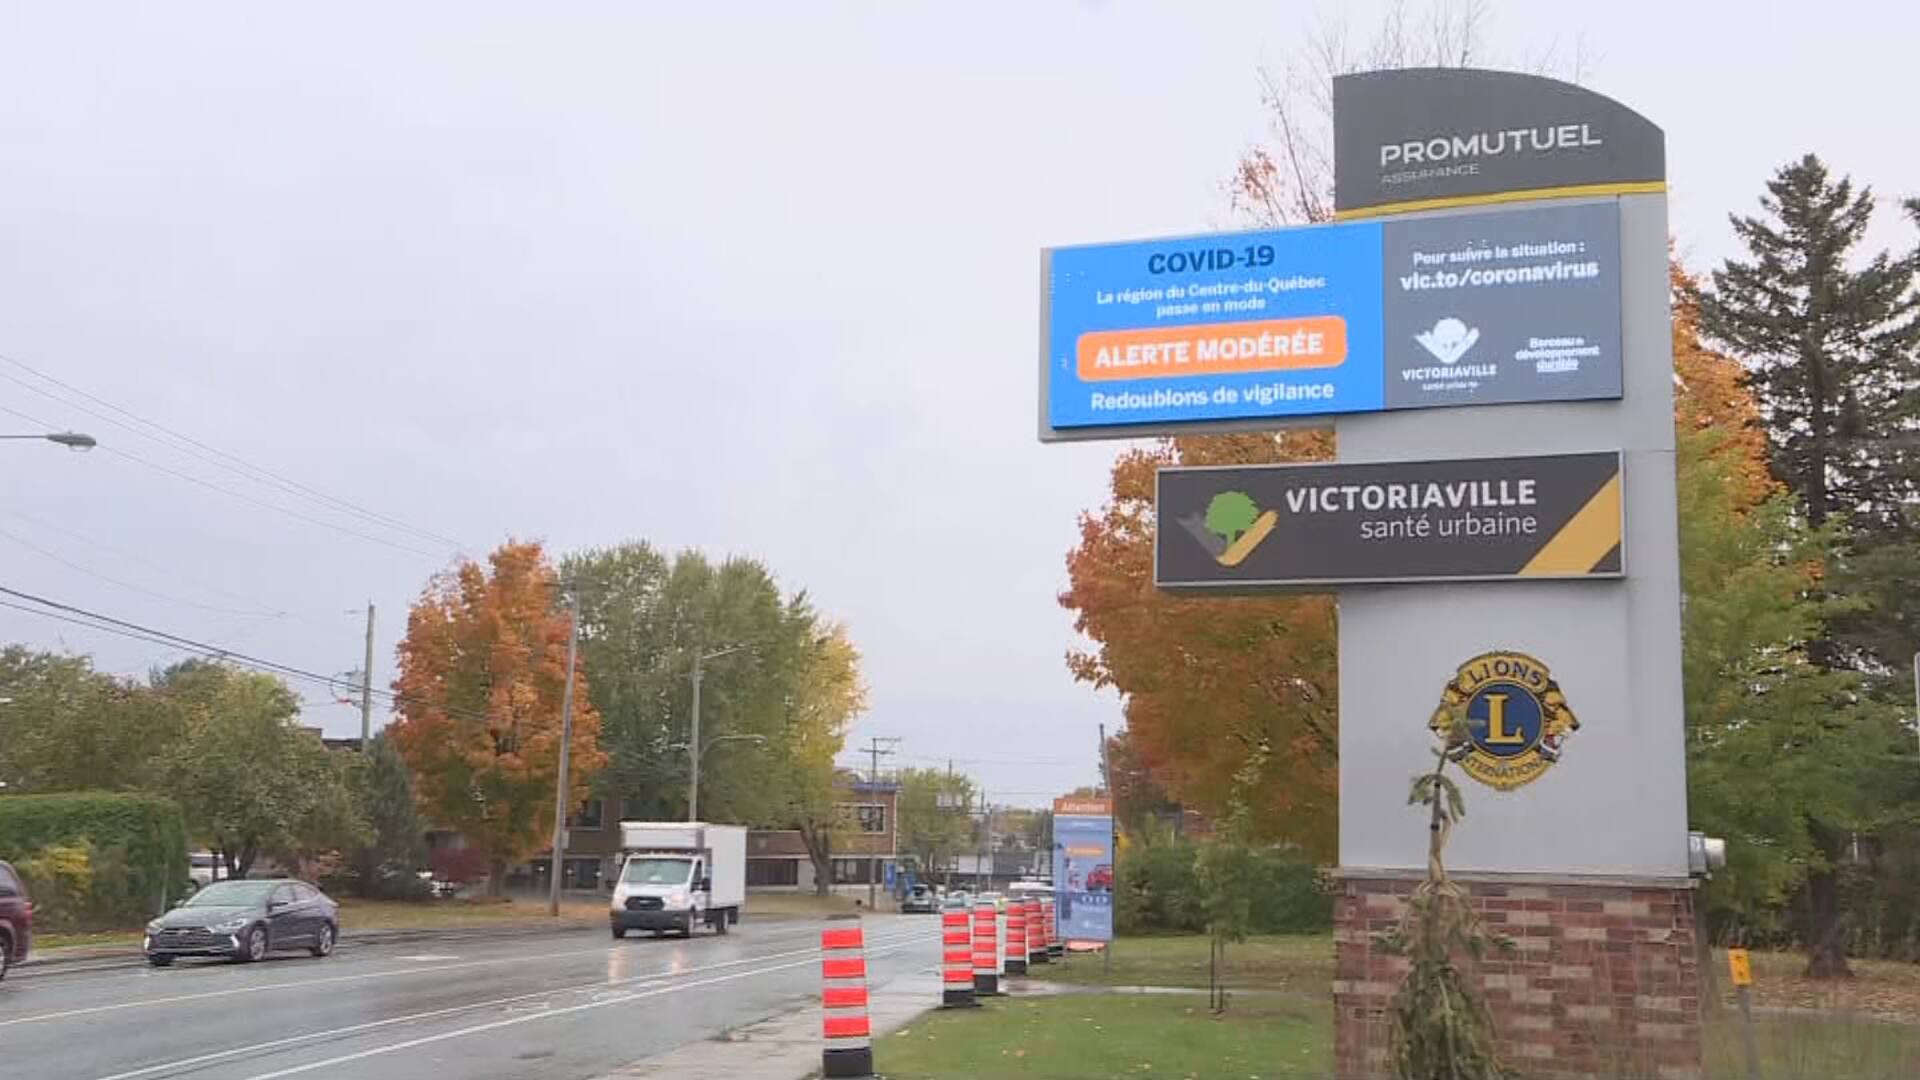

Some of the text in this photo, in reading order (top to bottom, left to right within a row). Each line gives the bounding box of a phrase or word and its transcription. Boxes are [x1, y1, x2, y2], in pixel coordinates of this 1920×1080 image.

[1380, 124, 1602, 166] PROMUTUEL
[1148, 244, 1275, 275] COVID-19
[1413, 251, 1446, 265] Pour
[1449, 247, 1492, 263] suivre
[1495, 245, 1508, 259] la
[1512, 241, 1577, 257] situation
[1400, 261, 1600, 291] vic.to/coronavirus
[1097, 290, 1113, 304] La
[1117, 288, 1162, 305] région
[1166, 285, 1185, 299] du
[1202, 302, 1221, 314] en
[1224, 296, 1266, 312] mode
[1095, 330, 1324, 368] ALERTE MODÉRÉE
[1402, 363, 1497, 381] VICTORIAVILLE
[1092, 380, 1335, 411] Redoublons de vigilance
[1286, 479, 1536, 513] VICTORIAVILLE
[1361, 511, 1536, 539] santé urbaine
[1467, 660, 1543, 686] LIONS
[1484, 693, 1525, 744] L
